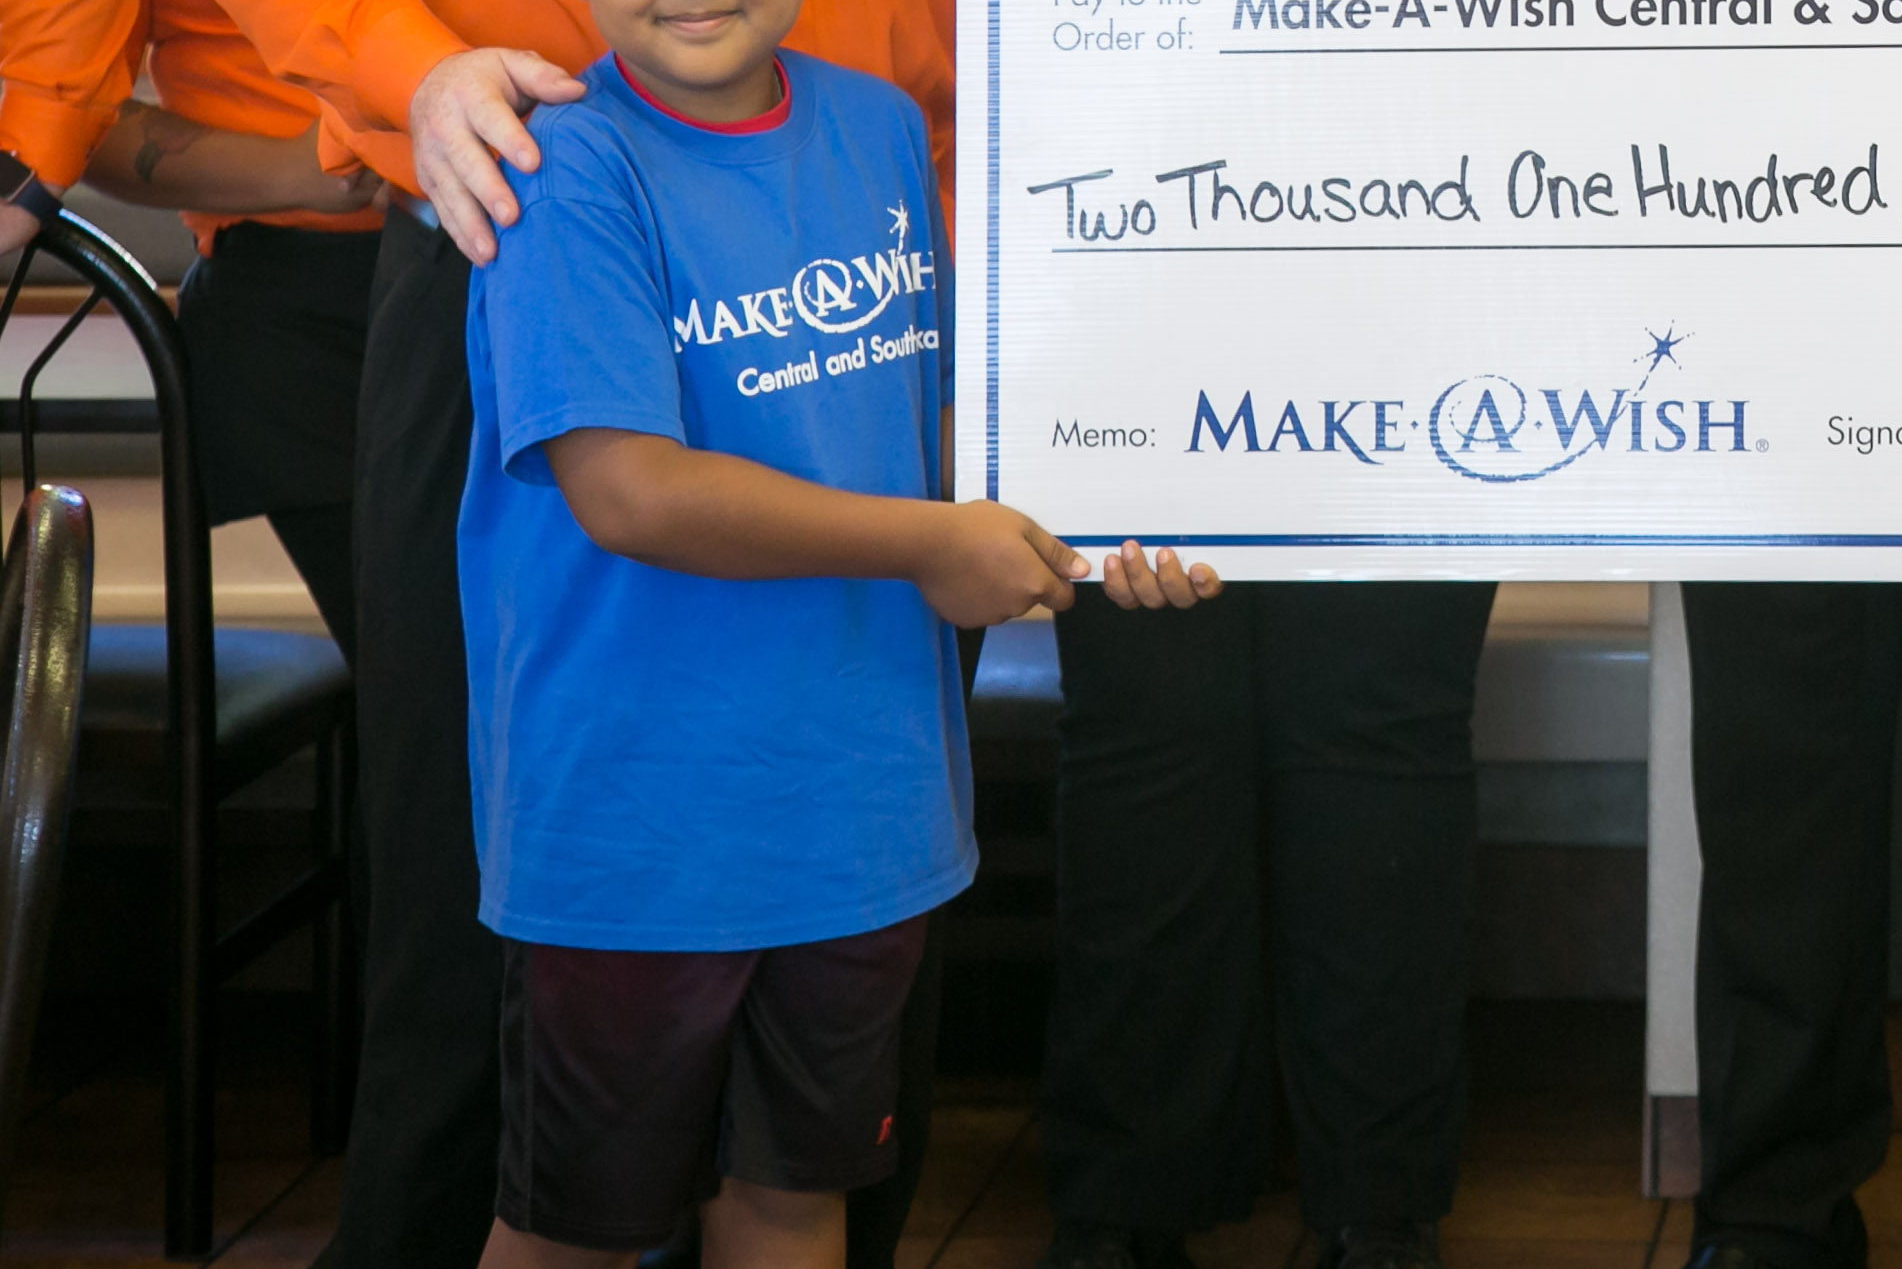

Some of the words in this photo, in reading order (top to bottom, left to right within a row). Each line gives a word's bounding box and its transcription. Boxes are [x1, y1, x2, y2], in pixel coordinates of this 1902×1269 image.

[1053, 20, 1140, 51] Order
[1150, 17, 1194, 51] of:
[1028, 168, 1157, 241] Two
[1156, 156, 1482, 230] Thousand
[1508, 150, 1616, 218] One
[1630, 143, 1888, 224] Hundred
[737, 350, 819, 396] Central
[825, 337, 866, 376] and
[1051, 418, 1155, 449] Memo:
